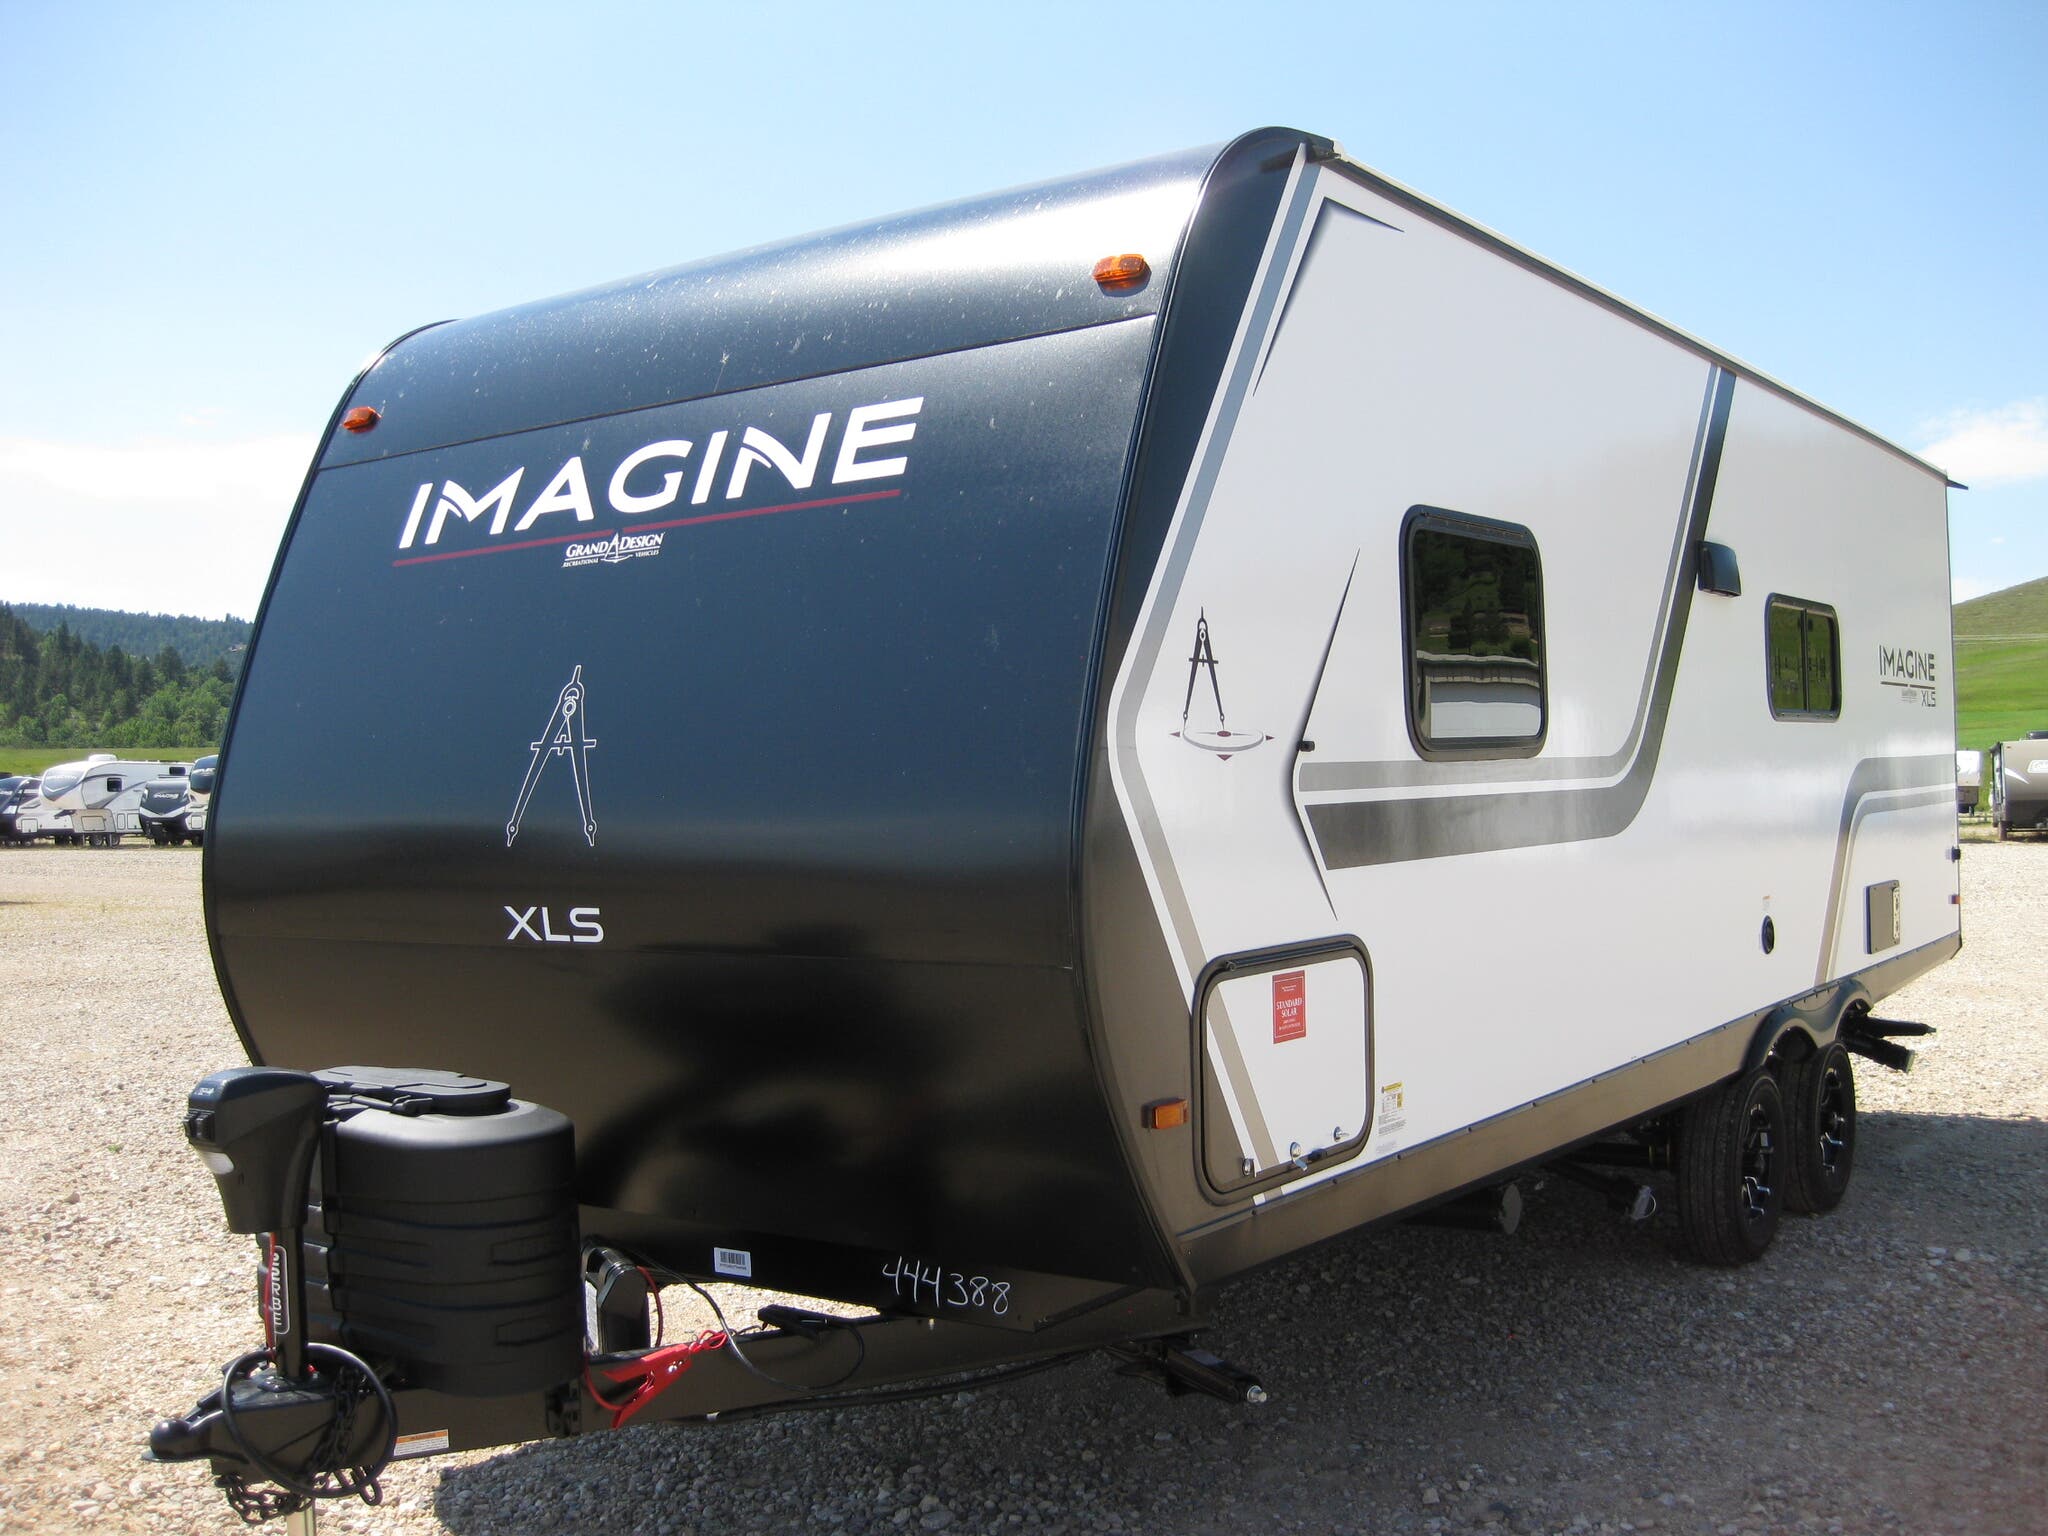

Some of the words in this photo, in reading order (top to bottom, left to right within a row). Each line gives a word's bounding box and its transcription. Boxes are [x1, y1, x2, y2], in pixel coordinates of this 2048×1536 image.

[398, 396, 925, 549] IMAGINE
[565, 541, 610, 558] GRAND
[620, 532, 664, 551] DESIGN
[1879, 644, 1936, 682] IMAGINE
[1921, 689, 1937, 708] XLS
[503, 905, 605, 943] XLS
[882, 1255, 1011, 1315] 444388
